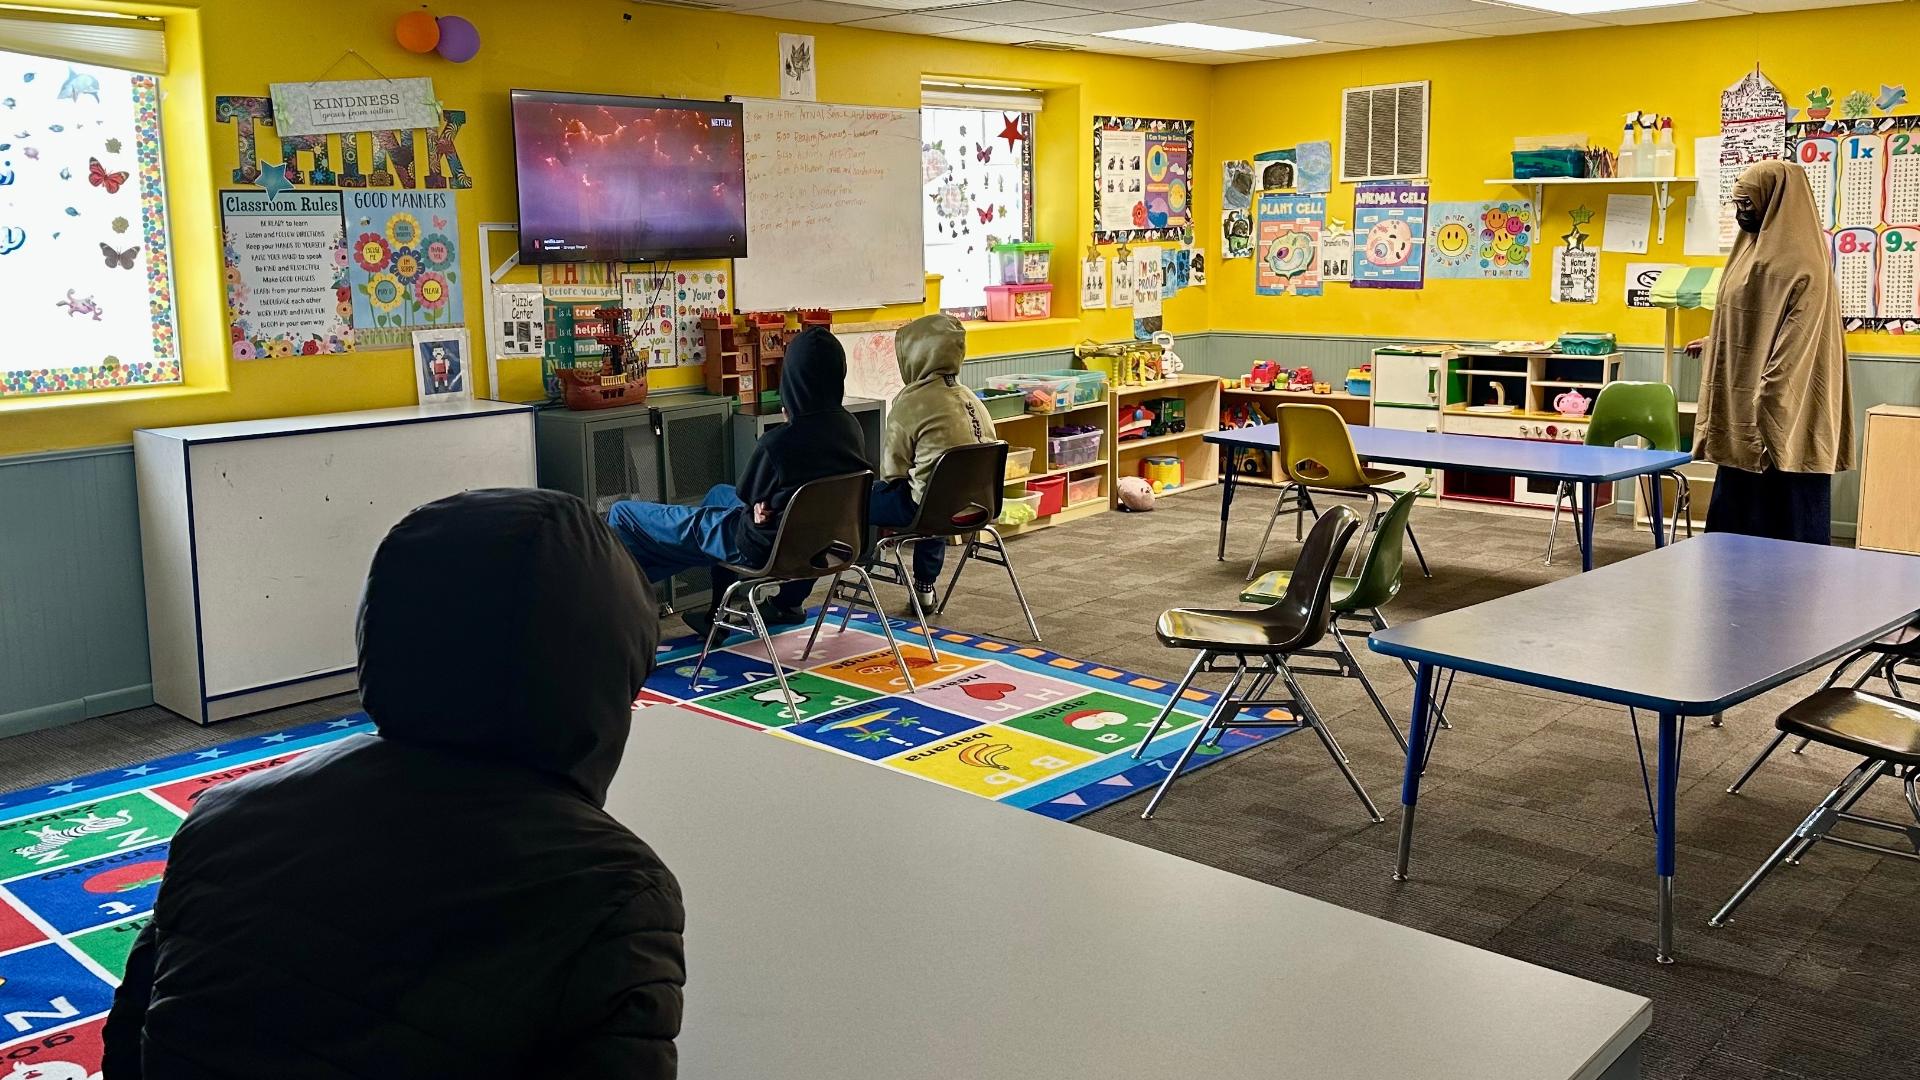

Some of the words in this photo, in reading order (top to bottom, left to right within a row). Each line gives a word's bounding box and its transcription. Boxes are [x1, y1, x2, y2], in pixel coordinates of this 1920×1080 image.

[313, 94, 400, 110] KINDNESS
[348, 109, 368, 120] from
[711, 118, 733, 128] NETFLIX
[1849, 138, 1875, 159] 1x
[1892, 134, 1920, 156] 2x
[1801, 142, 1832, 163] 0x
[226, 196, 297, 212] Classroom
[301, 196, 338, 212] Rules
[354, 192, 388, 208] GOOD
[391, 192, 447, 208] MANNERS
[1355, 191, 1397, 205] ANIMAL
[1400, 192, 1427, 205] CELL
[1260, 202, 1293, 215] PLANT
[1296, 202, 1324, 214] CELL
[1839, 232, 1872, 254] 8x
[1885, 231, 1918, 253] 9x
[1148, 262, 1158, 273] SO
[1570, 259, 1587, 267] Home
[1570, 266, 1587, 277] Living
[624, 278, 642, 294] THE
[643, 277, 672, 291] WORLD
[1138, 275, 1158, 290] PROUD
[549, 287, 578, 297] Before
[581, 288, 597, 298] you
[600, 288, 621, 298] spea
[692, 288, 712, 302] Your
[1147, 290, 1158, 302] YOU
[511, 294, 533, 308] Puzzle
[511, 308, 534, 320] Center
[633, 322, 656, 337] with
[649, 337, 666, 352] you
[830, 648, 896, 670] orange
[933, 663, 966, 672] O
[928, 672, 988, 692] heart
[830, 695, 858, 706] P
[1026, 688, 1065, 701] H
[983, 702, 1023, 712] h
[1031, 700, 1089, 721] apple
[886, 736, 914, 747] i
[1094, 733, 1126, 744] a
[904, 732, 994, 762] banana
[1030, 755, 1071, 769] B
[983, 771, 1028, 785] b
[0, 804, 99, 831] zebra
[41, 845, 169, 881] omato
[98, 901, 137, 915] t
